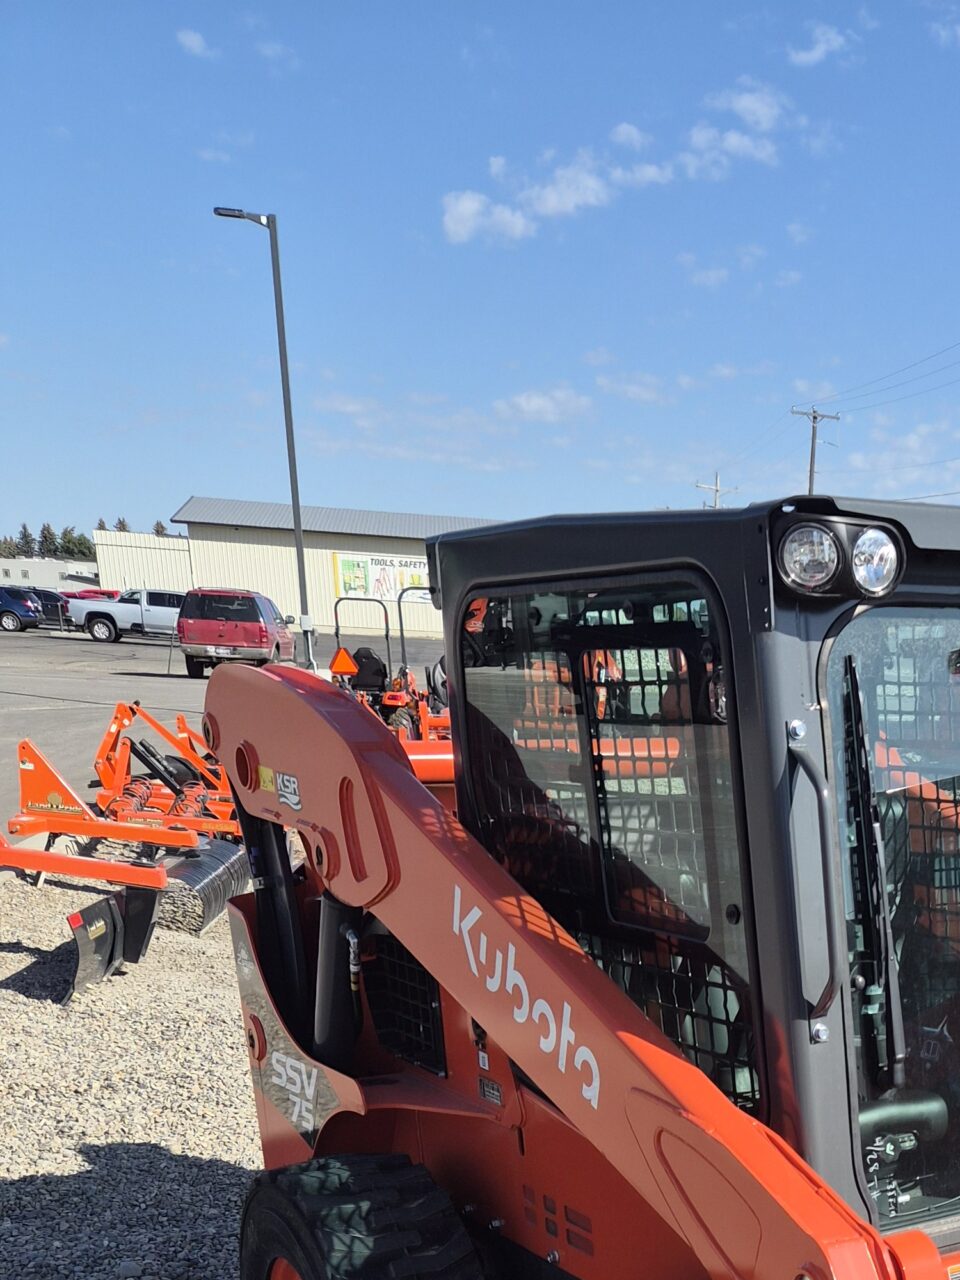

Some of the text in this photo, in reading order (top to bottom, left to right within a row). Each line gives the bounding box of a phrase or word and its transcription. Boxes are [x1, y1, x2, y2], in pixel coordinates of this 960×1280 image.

[370, 558, 427, 569] TOOLS, SAFETY
[276, 772, 300, 796] KSR
[452, 884, 601, 1110] Kubota
[271, 1050, 318, 1100] SSV
[288, 1093, 314, 1132] 75
